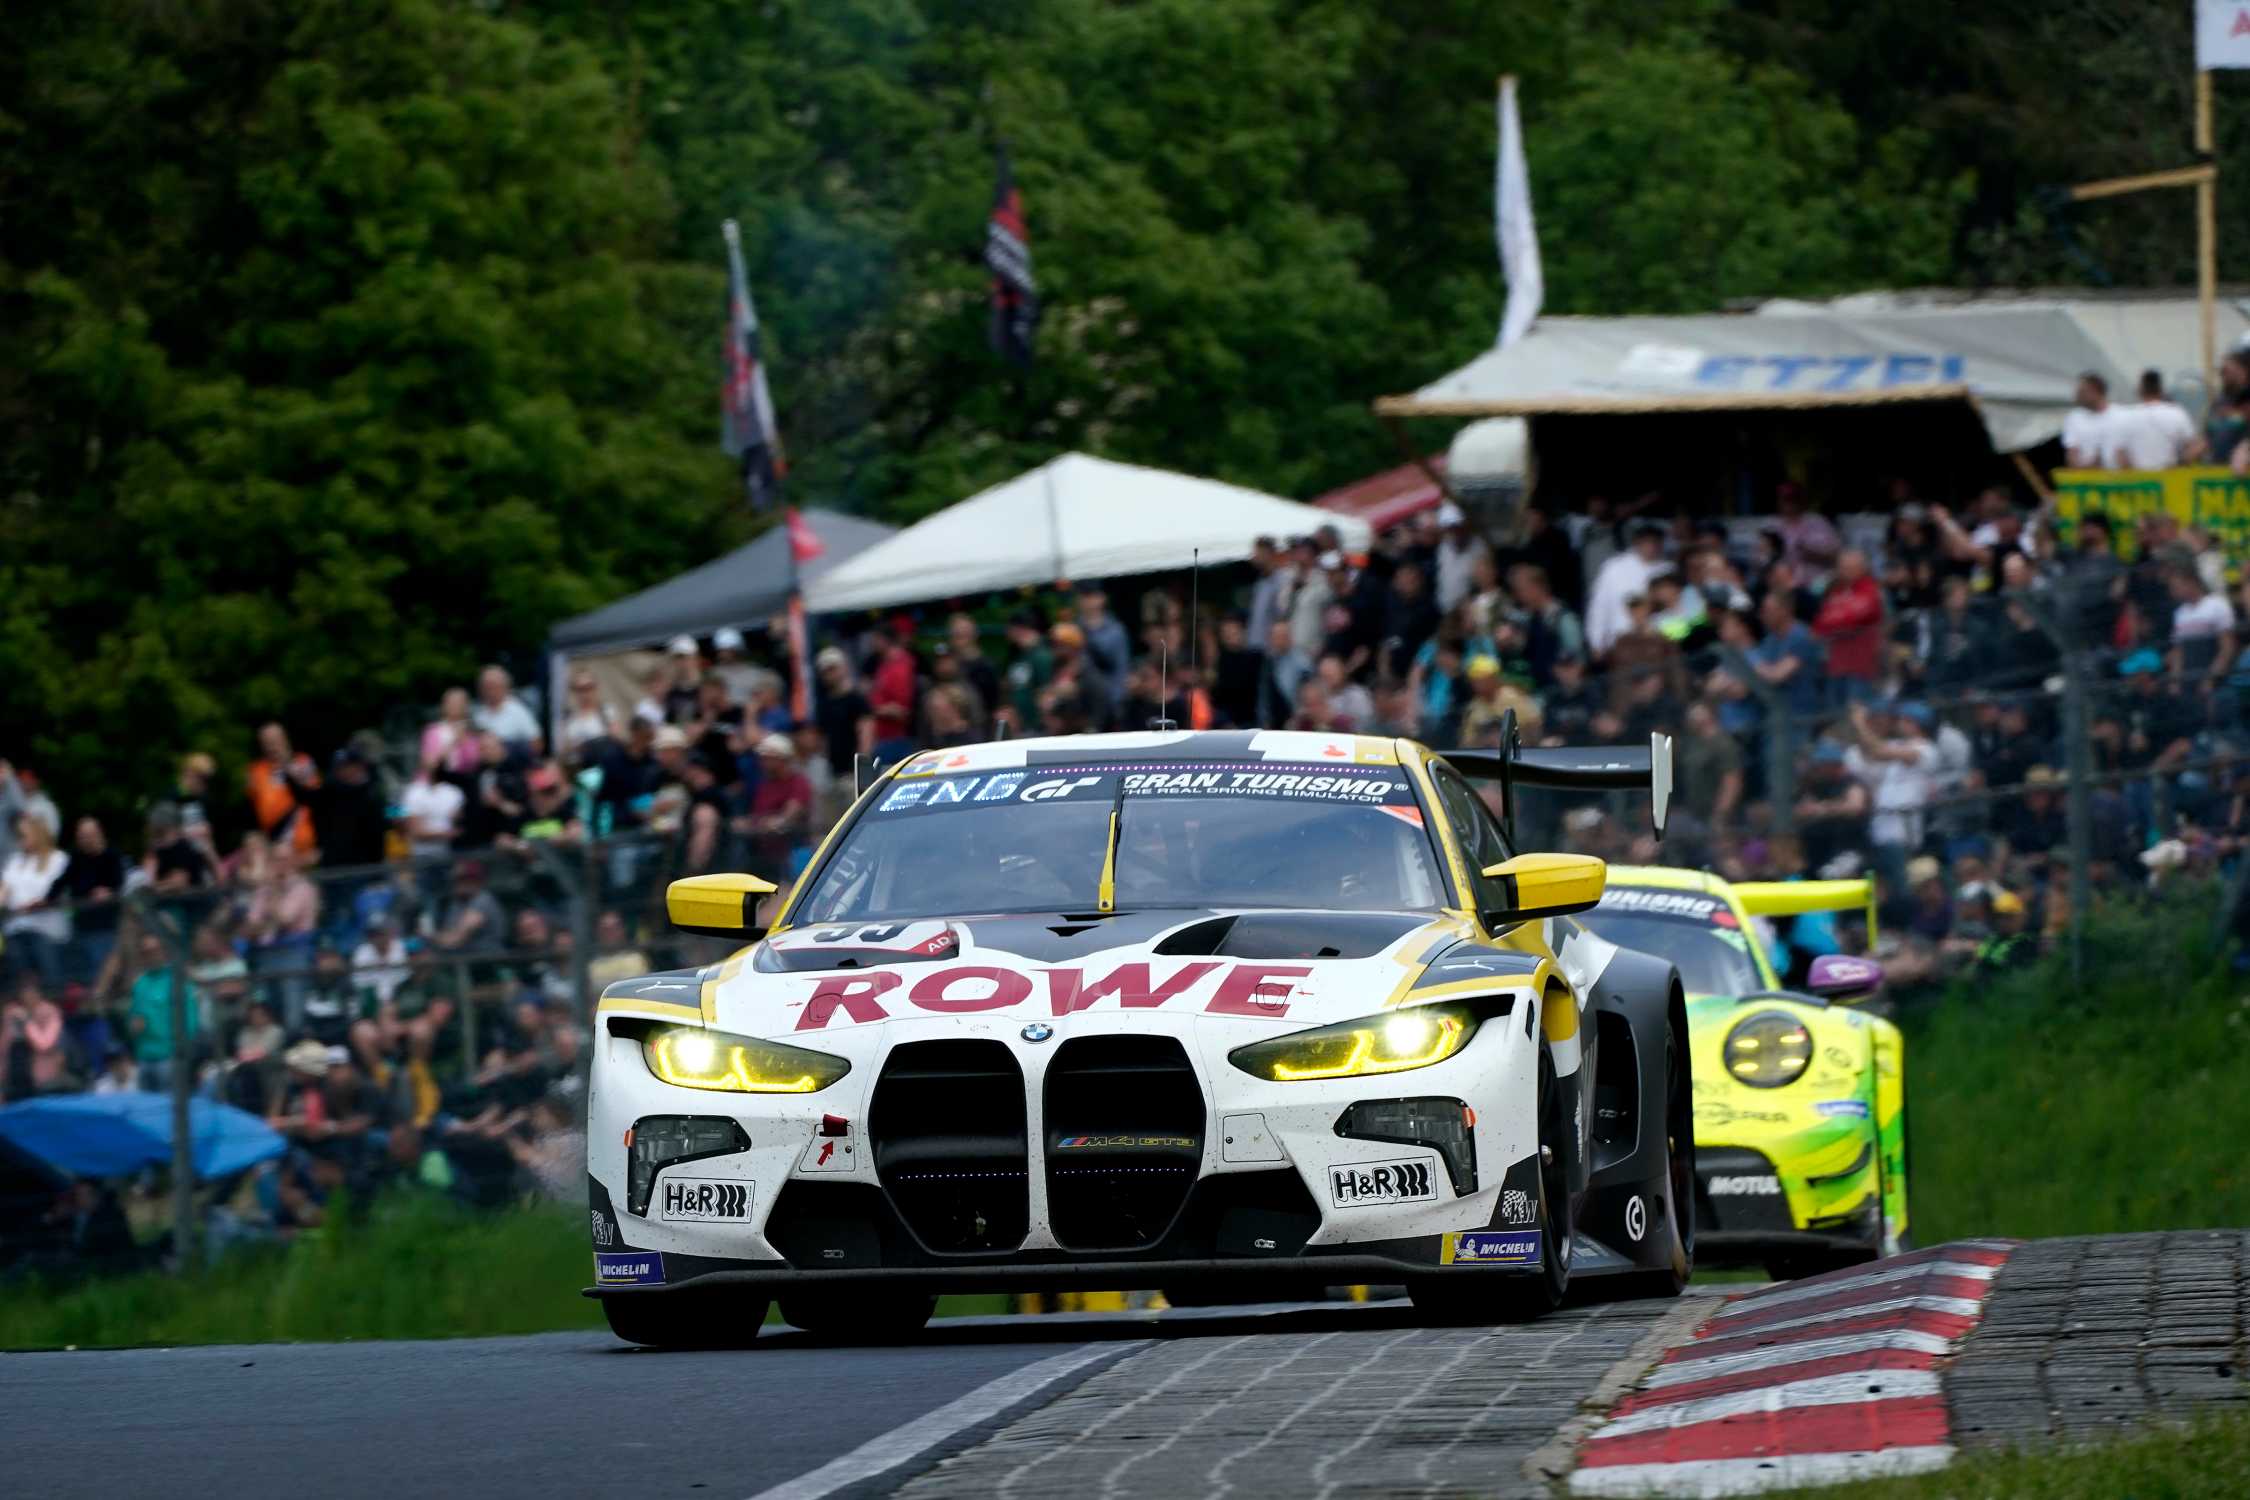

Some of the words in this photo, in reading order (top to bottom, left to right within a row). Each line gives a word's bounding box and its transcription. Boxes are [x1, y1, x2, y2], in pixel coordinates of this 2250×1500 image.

[1124, 773, 1223, 789] GRAN
[1230, 773, 1392, 796] TURISMO
[1206, 787, 1278, 796] DRIVING
[1283, 789, 1384, 803] SIMULATOR
[795, 962, 1314, 1031] ROWE
[1333, 1167, 1398, 1202] H&R
[1708, 1175, 1781, 1195] MOTUL
[665, 1183, 717, 1216] H&R
[1508, 1199, 1538, 1225] KW
[1479, 1242, 1535, 1255] MICHELIN
[602, 1263, 650, 1276] MICHELIN
